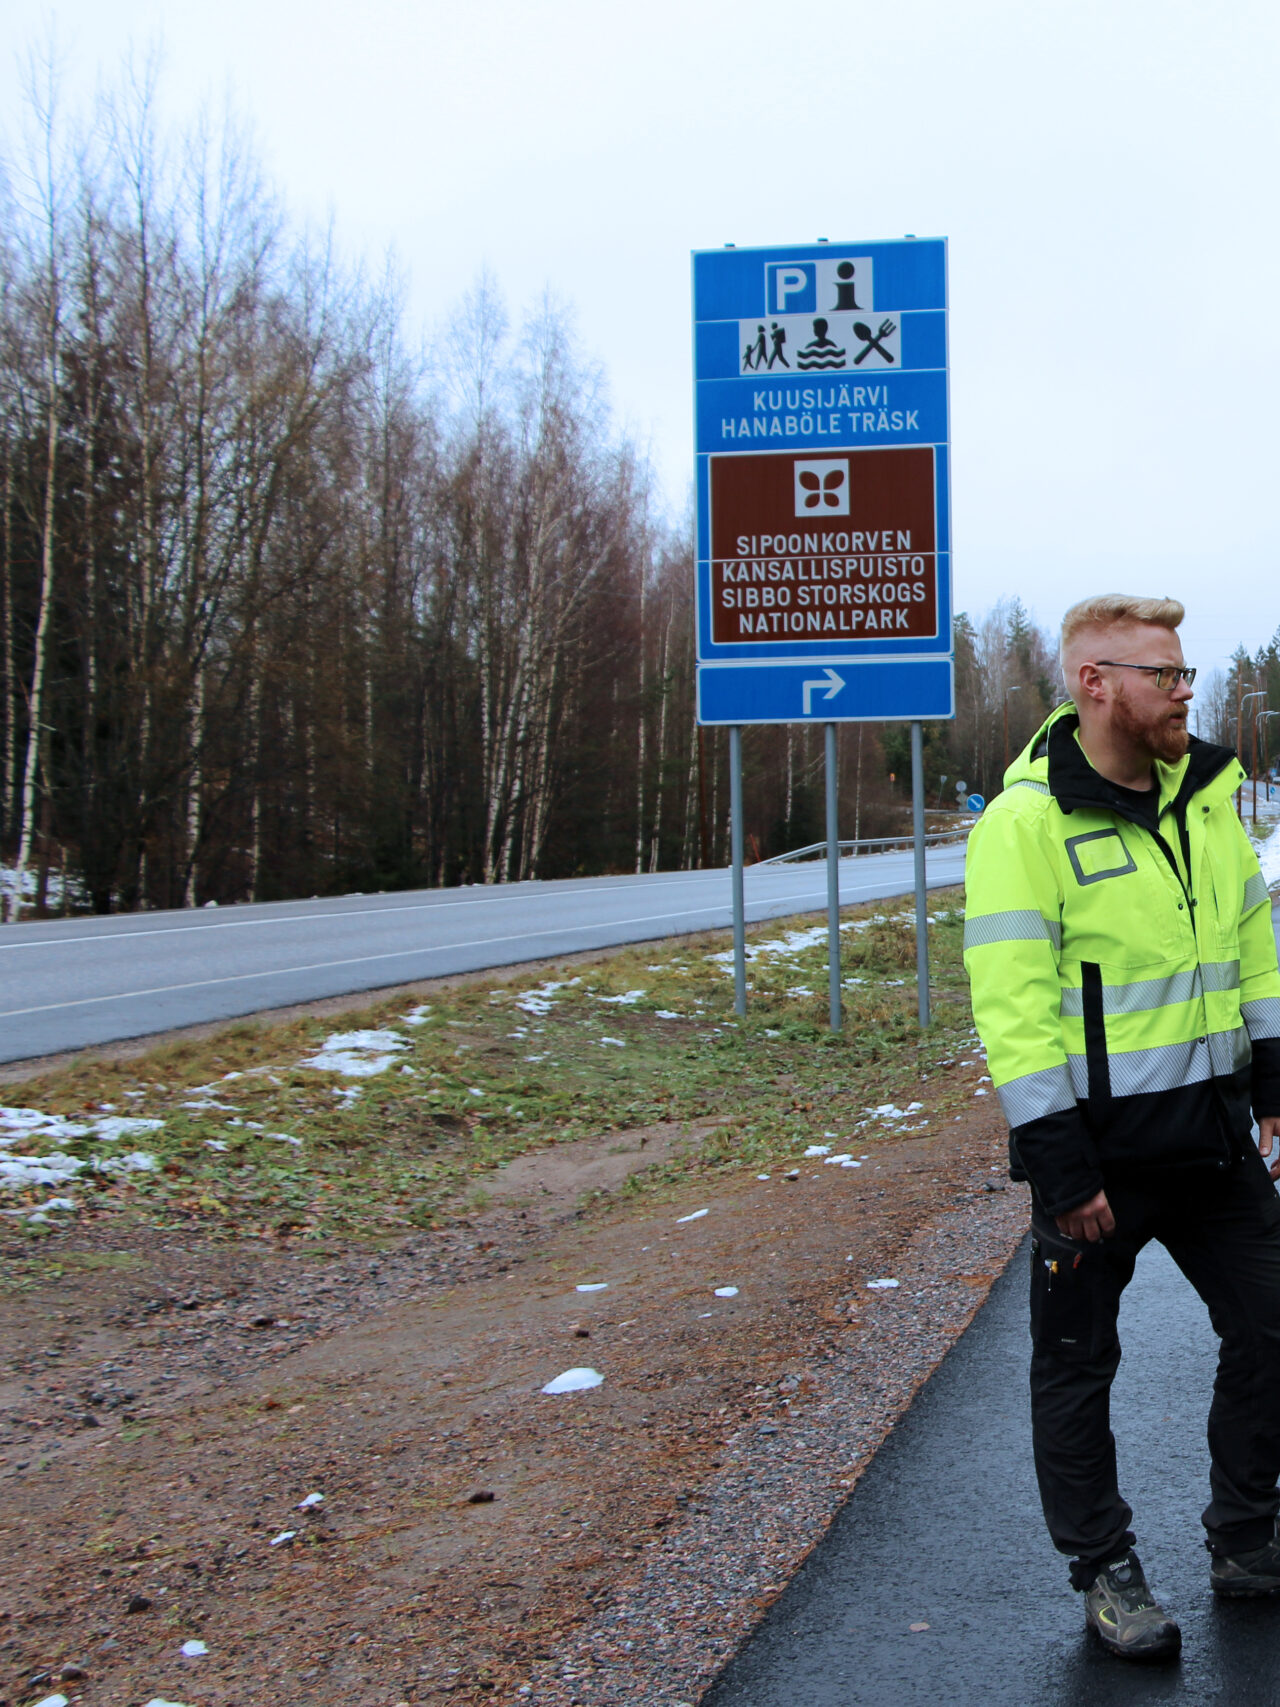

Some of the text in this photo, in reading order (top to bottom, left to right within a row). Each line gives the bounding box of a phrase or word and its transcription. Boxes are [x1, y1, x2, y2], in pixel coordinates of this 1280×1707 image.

[776, 268, 807, 311] P
[753, 384, 888, 411] KUUSIJÄRVI
[721, 408, 920, 438] HANABÖLE TRÄSK
[736, 530, 911, 555] SIPOONKORVEN
[722, 556, 925, 582] KANSALLISPUISTO
[722, 582, 926, 608] SIBBO STORSKOGS
[739, 608, 909, 634] NATIONALPARK
